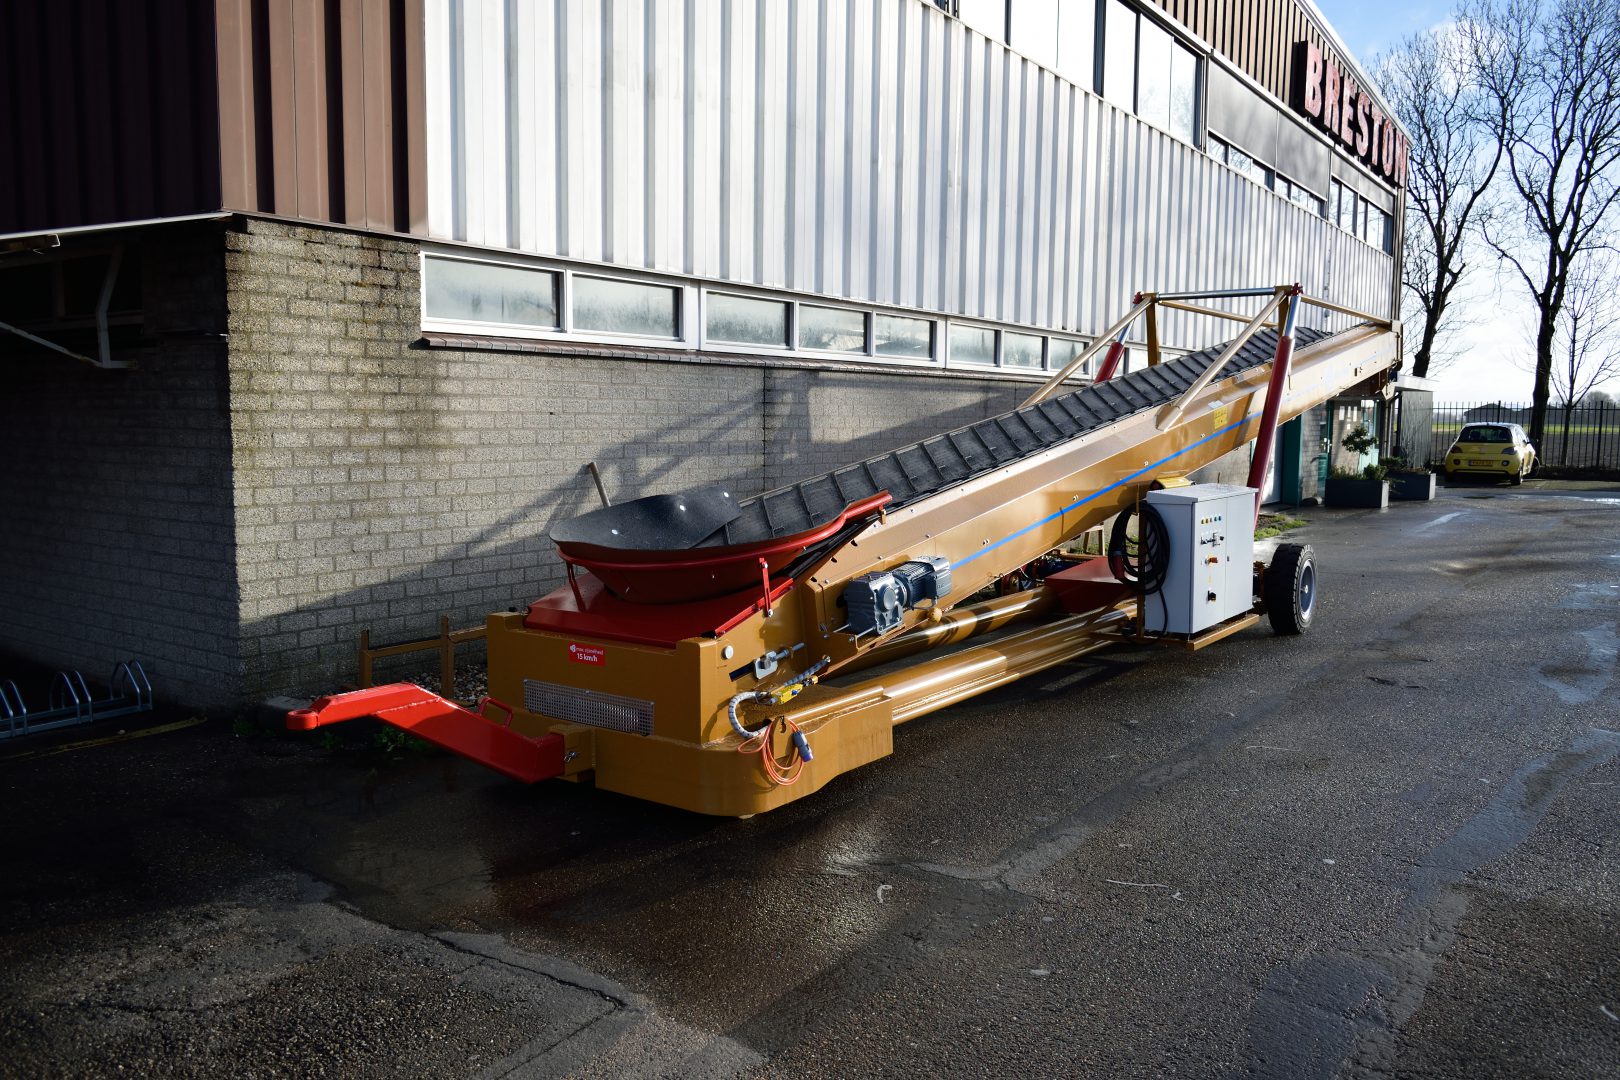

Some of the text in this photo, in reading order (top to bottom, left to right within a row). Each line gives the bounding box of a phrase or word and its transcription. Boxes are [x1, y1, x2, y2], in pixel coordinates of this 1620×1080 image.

[1304, 41, 1408, 188] BRESTON
[577, 652, 598, 662] 15 km/h
